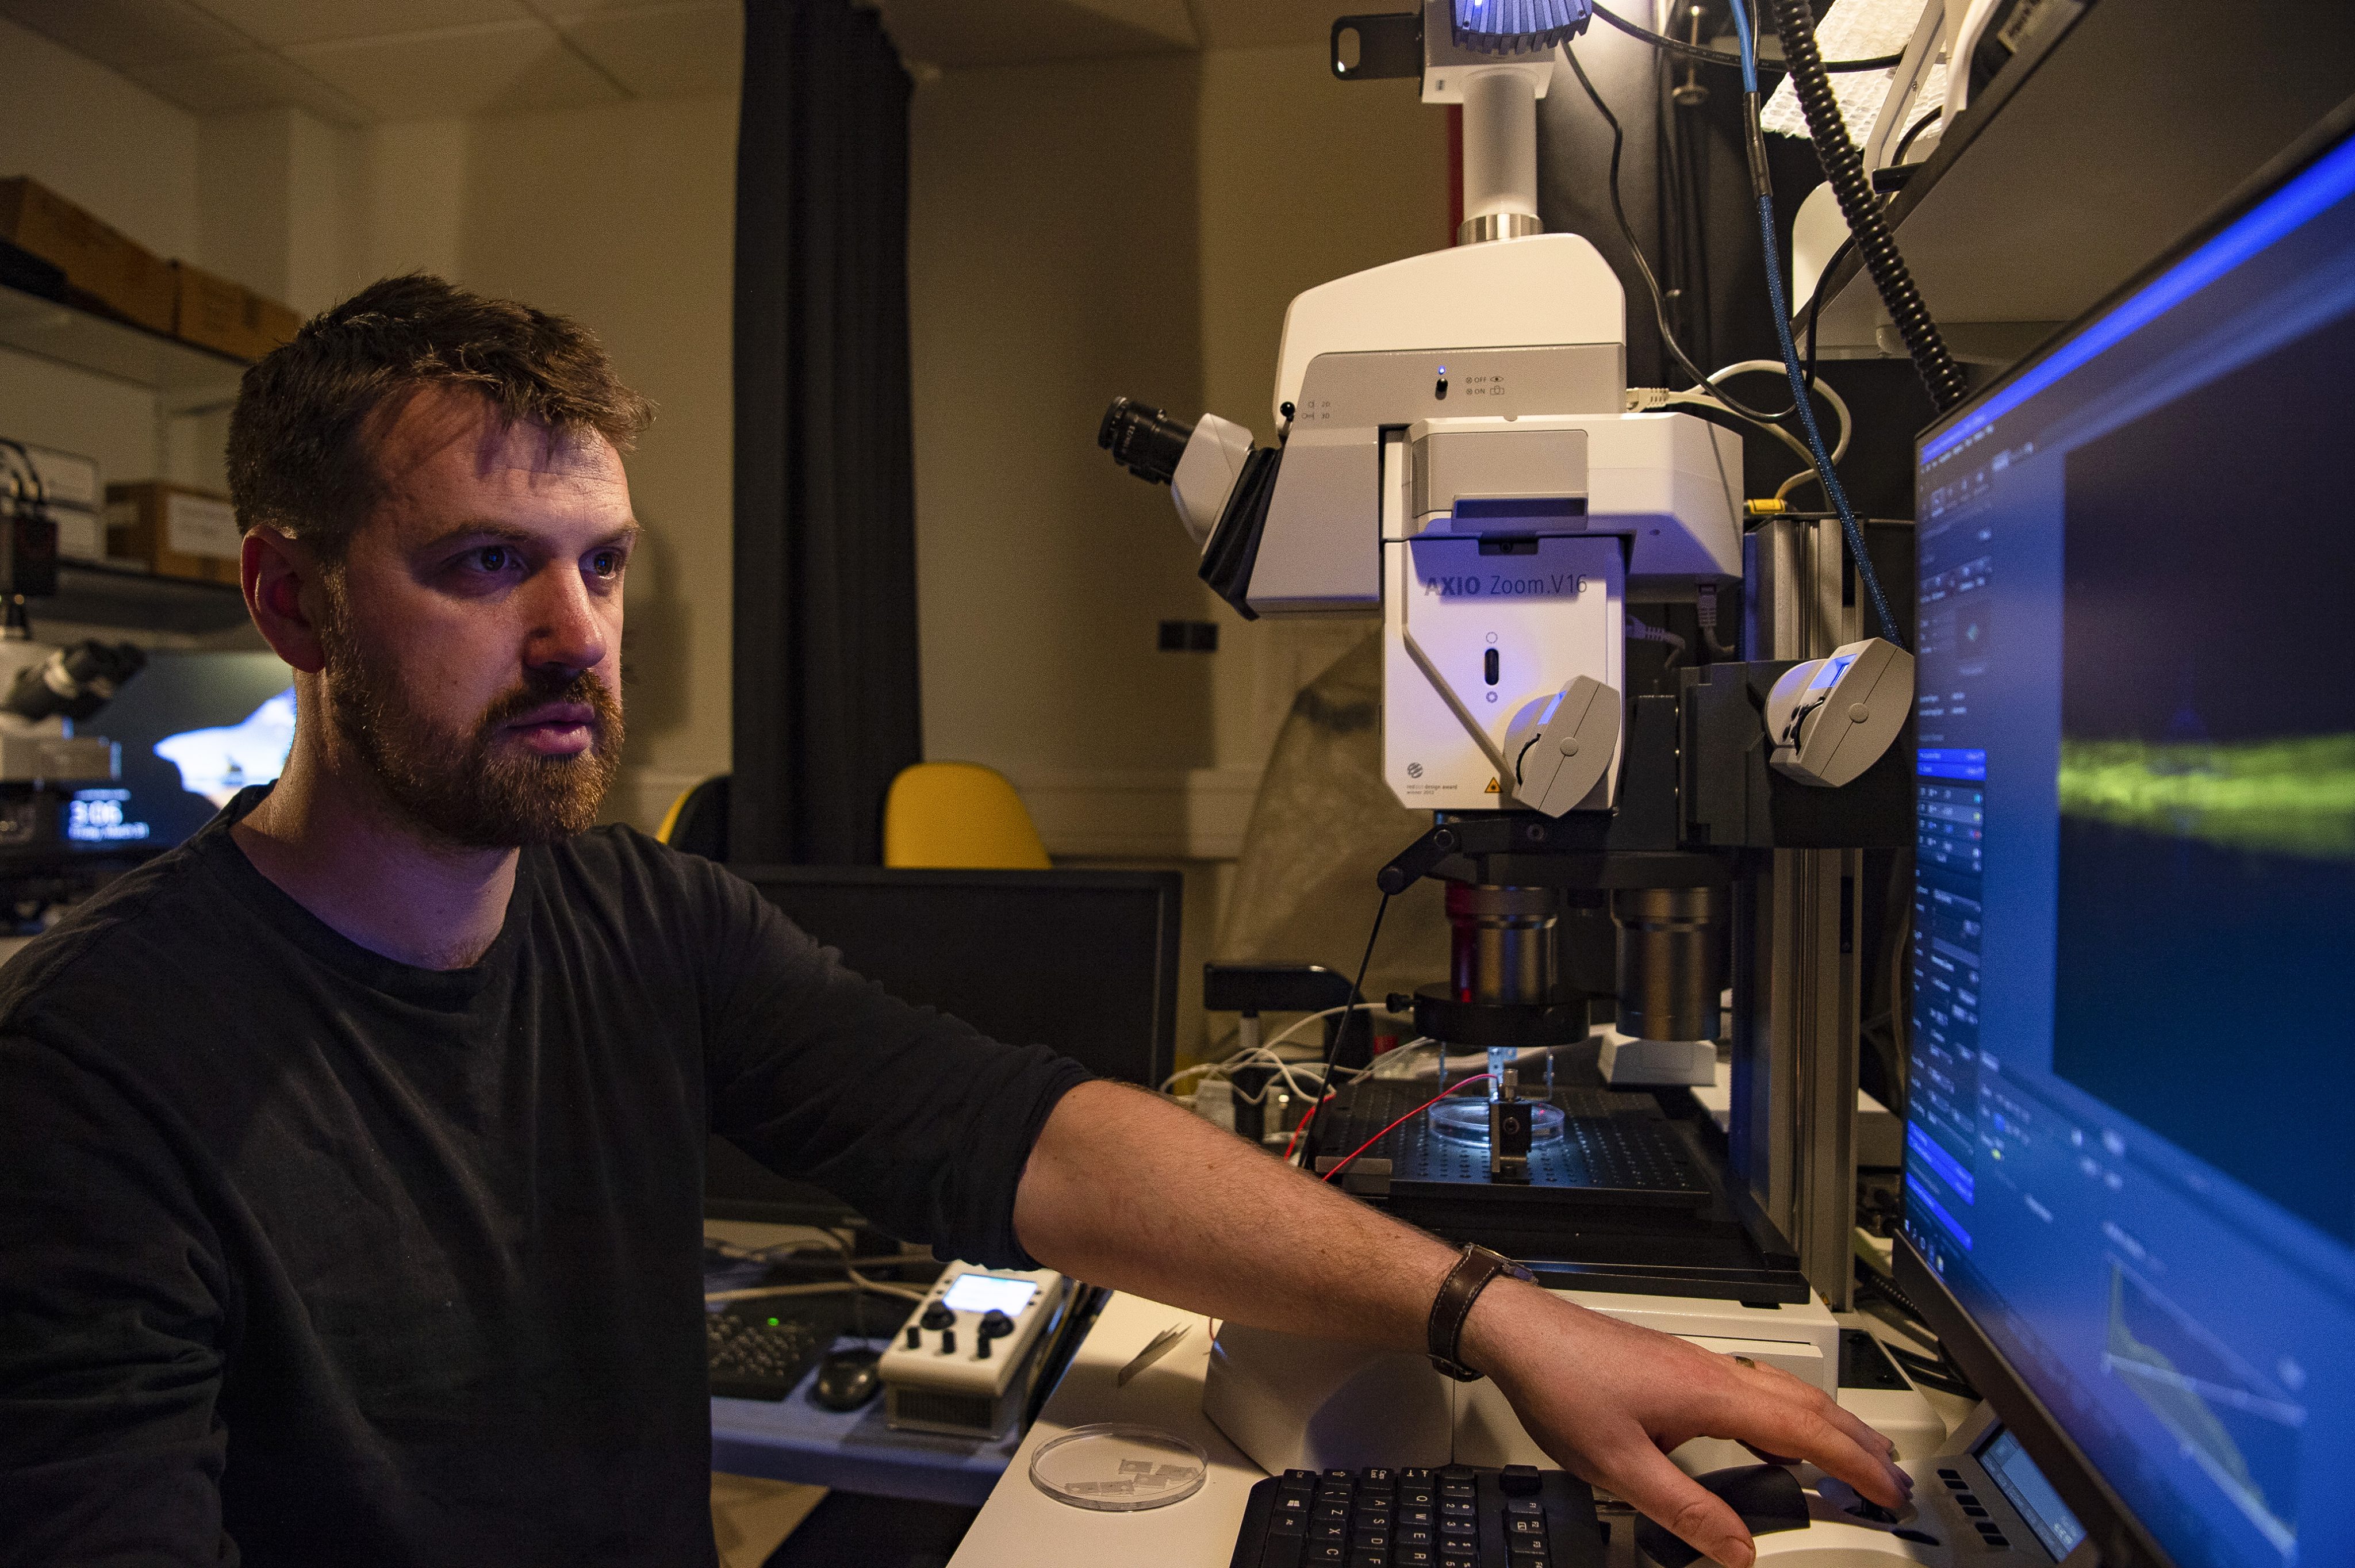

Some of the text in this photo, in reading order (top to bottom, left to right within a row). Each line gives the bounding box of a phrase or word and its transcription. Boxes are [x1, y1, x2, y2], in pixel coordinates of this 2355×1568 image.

[1424, 574, 1587, 596] AXIO Zoom.V16
[1379, 1470, 1387, 1479] Caps
